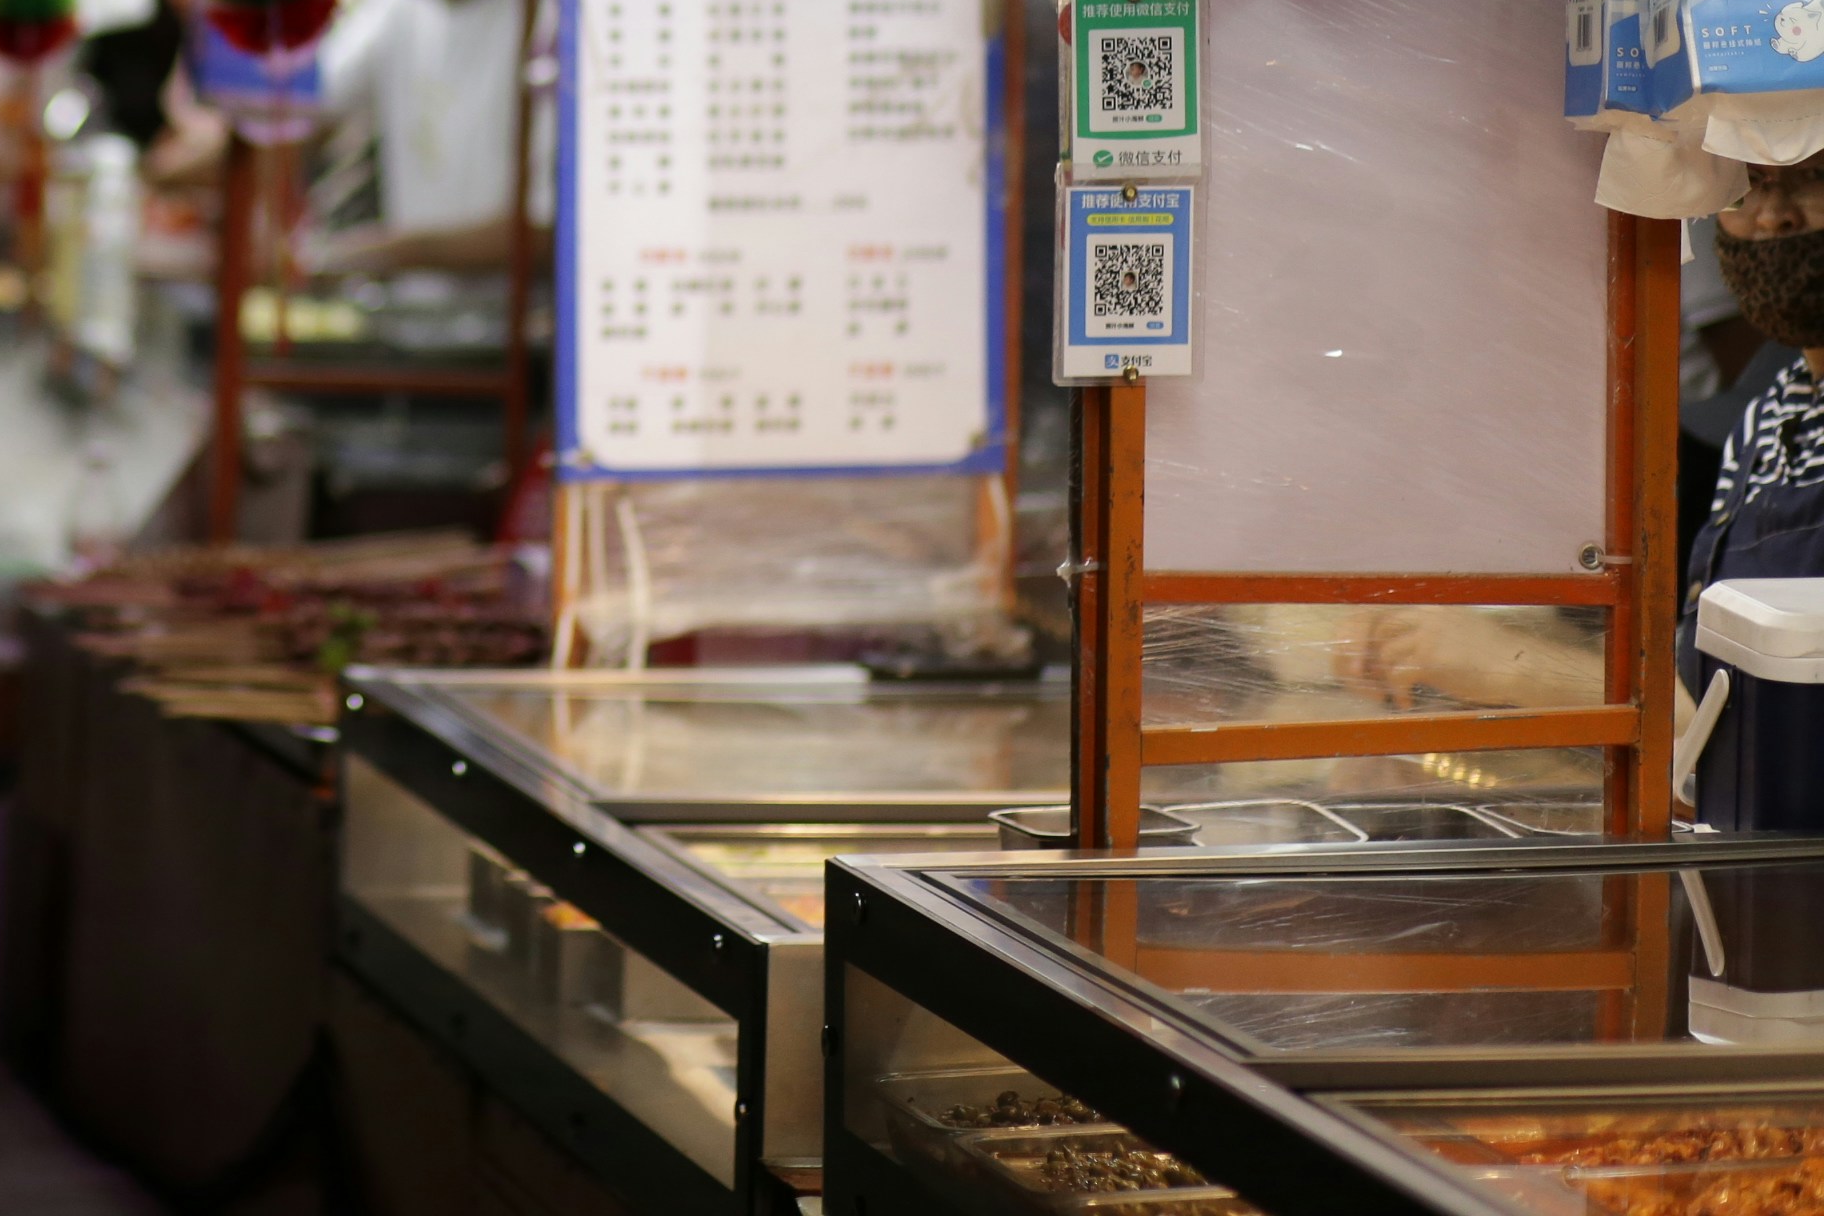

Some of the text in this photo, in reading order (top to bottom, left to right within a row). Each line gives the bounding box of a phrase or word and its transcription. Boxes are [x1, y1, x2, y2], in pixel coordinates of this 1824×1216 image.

[1082, 2, 1190, 19] 推荐使用微信支付
[1701, 25, 1752, 38] SOFT
[1119, 150, 1182, 167] 微信支付
[1121, 354, 1153, 367] 支付宝
